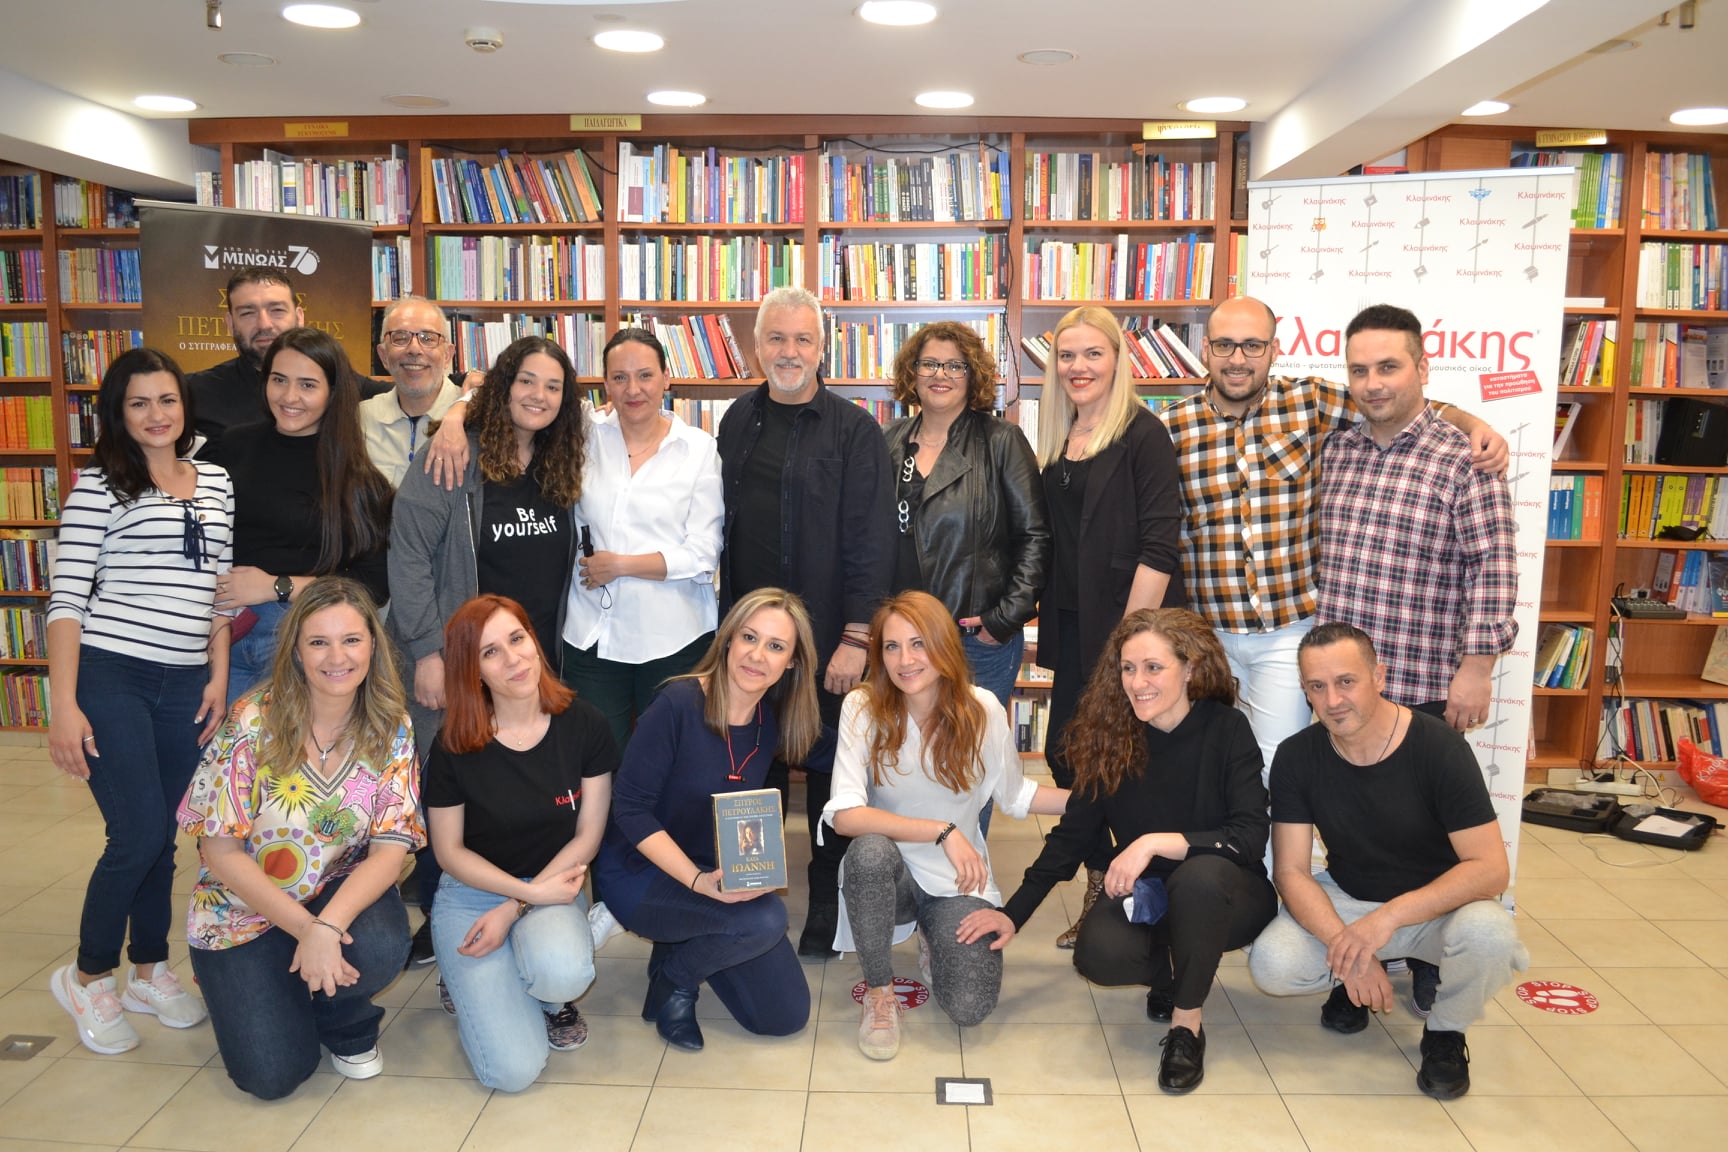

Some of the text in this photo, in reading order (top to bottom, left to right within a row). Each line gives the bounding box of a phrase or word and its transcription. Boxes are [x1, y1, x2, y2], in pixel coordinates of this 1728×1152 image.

[223, 252, 288, 268] ΜΙΝΩΑΣ
[188, 342, 238, 352] ΣΥΓΓΡΑΦΕΑ
[516, 508, 536, 522] Be
[492, 516, 558, 542] yourself
[732, 862, 776, 873] ΙΩΑΝΝΗ
[1531, 981, 1572, 989] STOP
[916, 986, 928, 1004] STOP
[1577, 990, 1597, 1009] STOP
